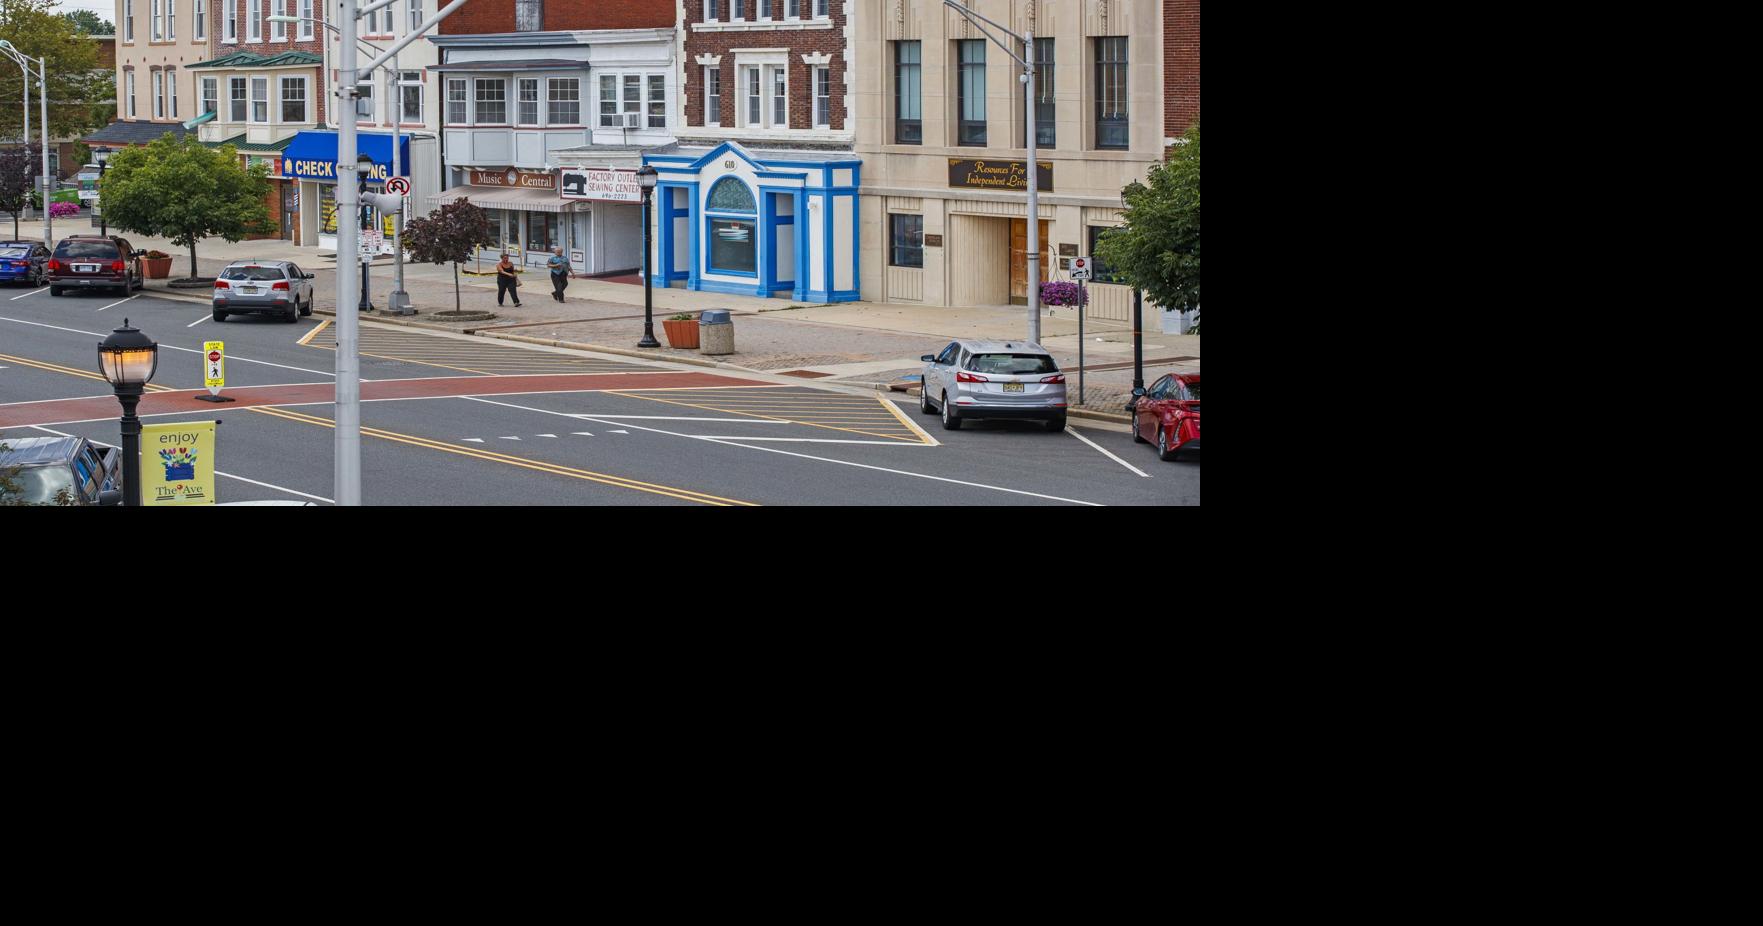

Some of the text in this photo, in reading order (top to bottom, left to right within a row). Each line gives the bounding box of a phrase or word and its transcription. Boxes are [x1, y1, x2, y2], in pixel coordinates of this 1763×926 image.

[295, 160, 333, 177] CHECK
[724, 160, 735, 169] 610
[974, 160, 1025, 174] Resources For
[478, 172, 552, 187] Music Central
[588, 171, 638, 183] FACTORY OUTLE
[966, 172, 1027, 187] Independent Livi
[588, 182, 640, 193] SEWING CENTER
[159, 432, 199, 445] enjoy
[155, 485, 203, 496] The Ave
